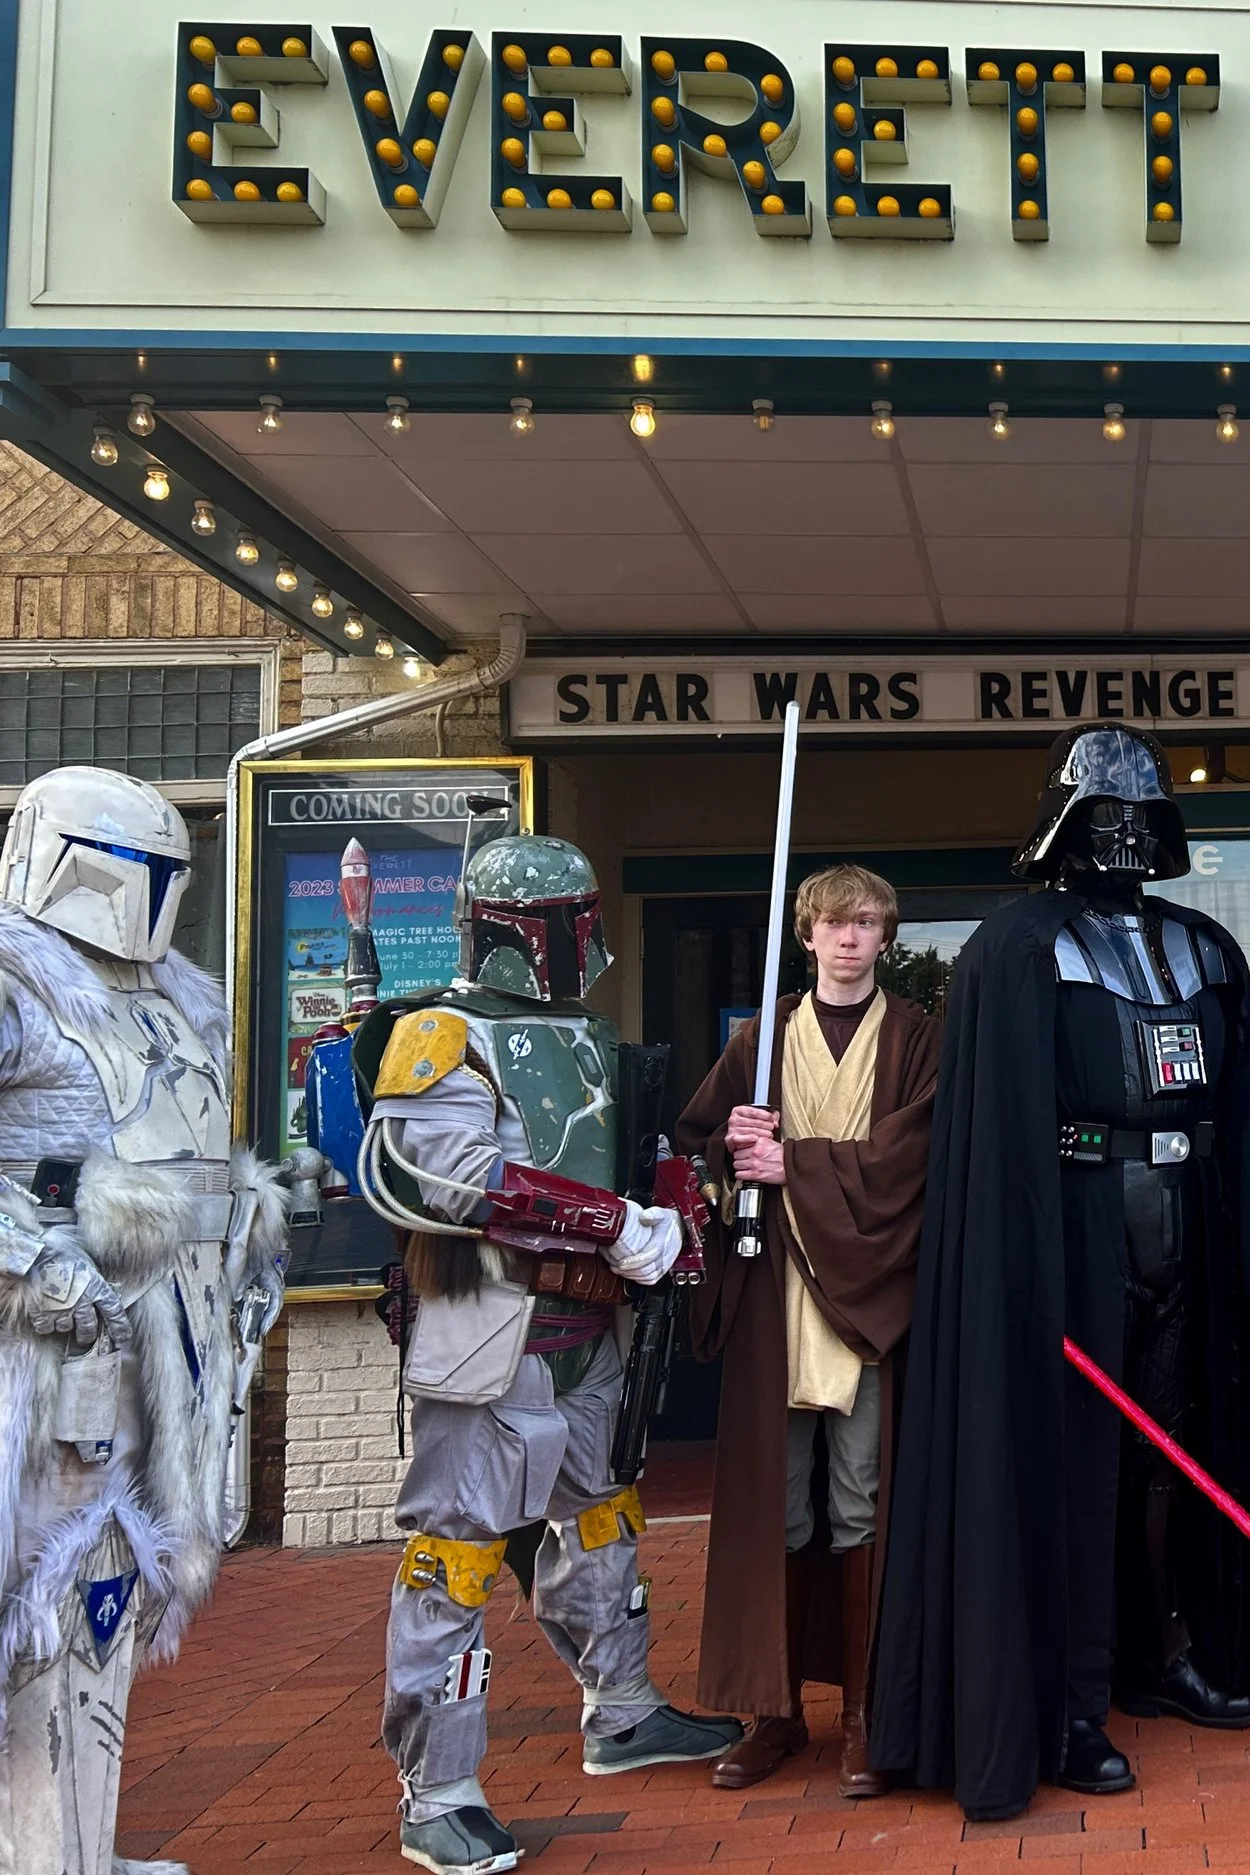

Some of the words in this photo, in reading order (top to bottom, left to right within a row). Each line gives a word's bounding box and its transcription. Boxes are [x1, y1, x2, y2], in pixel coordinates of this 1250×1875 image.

[172, 21, 1221, 243] EVERETT
[556, 673, 710, 724] STAR
[752, 671, 921, 721] WARS
[980, 669, 1235, 720] REVENGE
[289, 794, 402, 821] COMING
[411, 791, 489, 818] SOO
[288, 879, 335, 898] 2023
[409, 926, 433, 935] TREE
[400, 936, 427, 945] PAST
[378, 952, 398, 960] une
[417, 960, 441, 969] 2:00
[394, 978, 441, 988] DISNEY'S
[302, 1005, 331, 1018] Pooh
